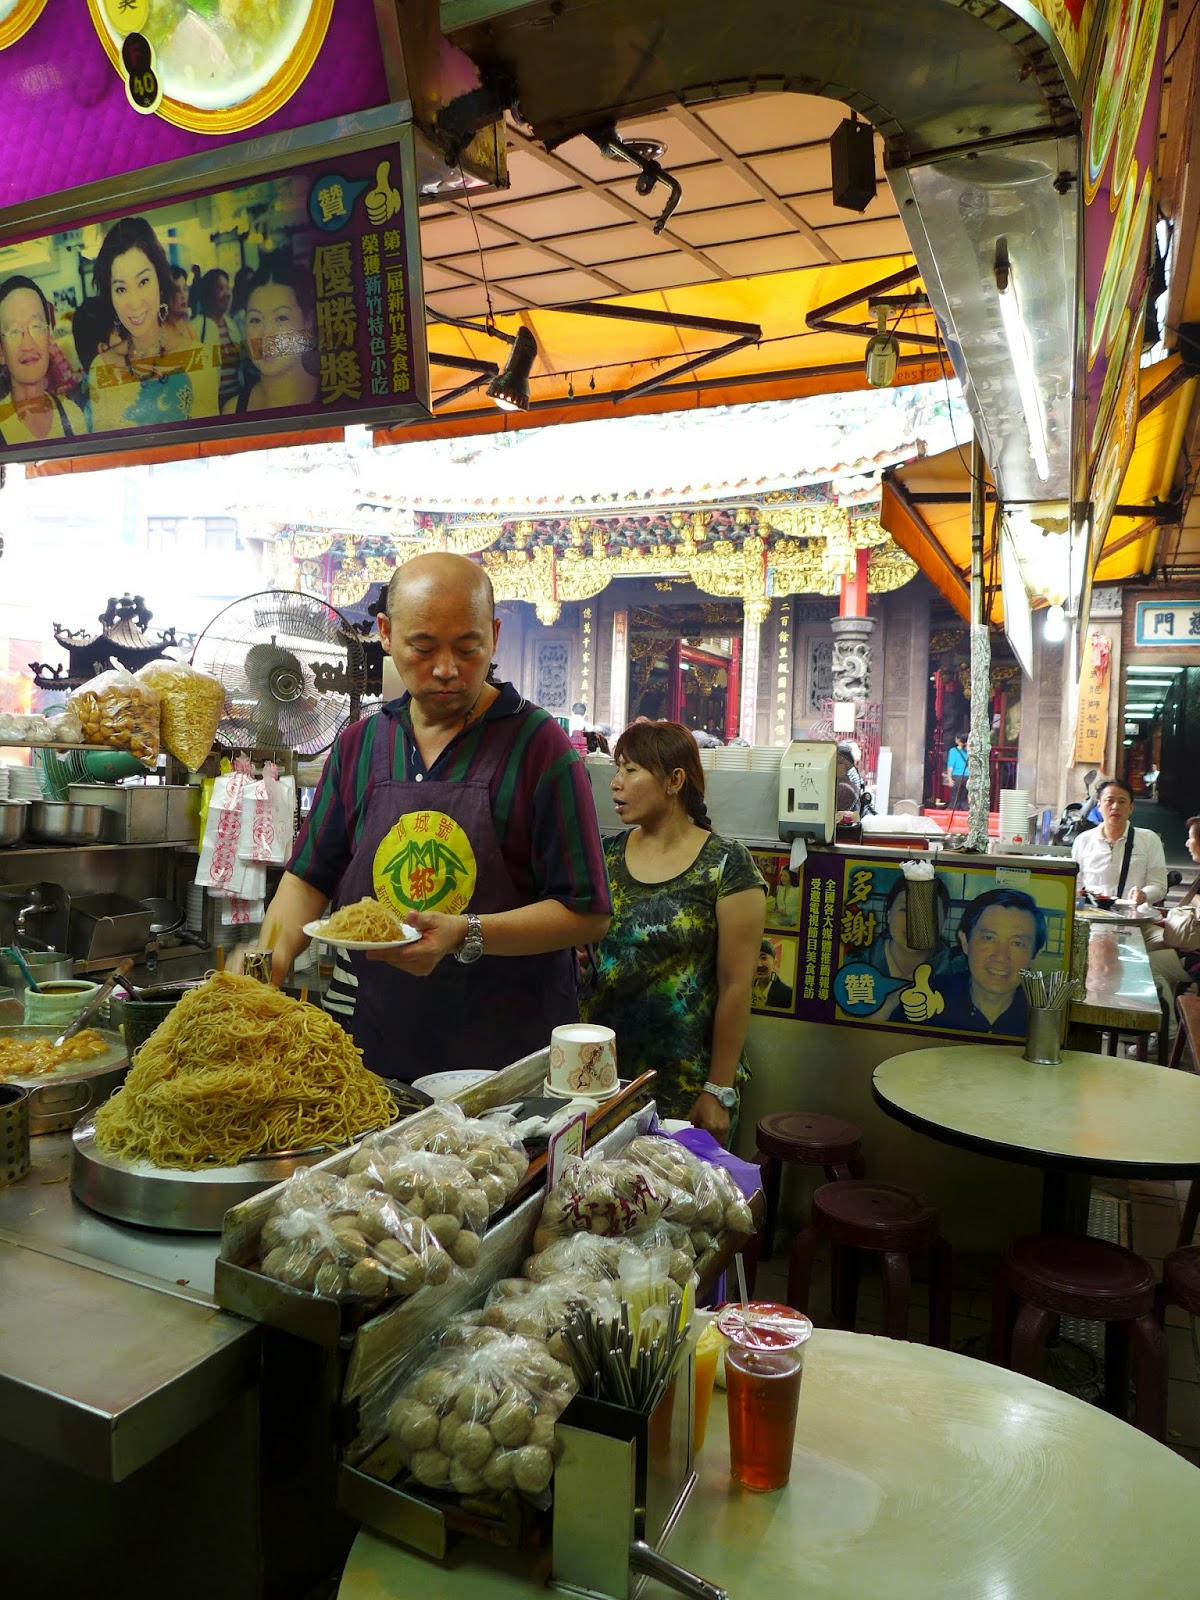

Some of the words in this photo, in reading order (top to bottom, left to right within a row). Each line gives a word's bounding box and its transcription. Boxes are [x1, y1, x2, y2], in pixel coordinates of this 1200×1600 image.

[312, 241, 362, 405] 優勝獎
[361, 233, 389, 396] 榮獲新竹特色小吃
[383, 229, 411, 393] 第二屆新竹美食節
[840, 870, 877, 947] 多謝
